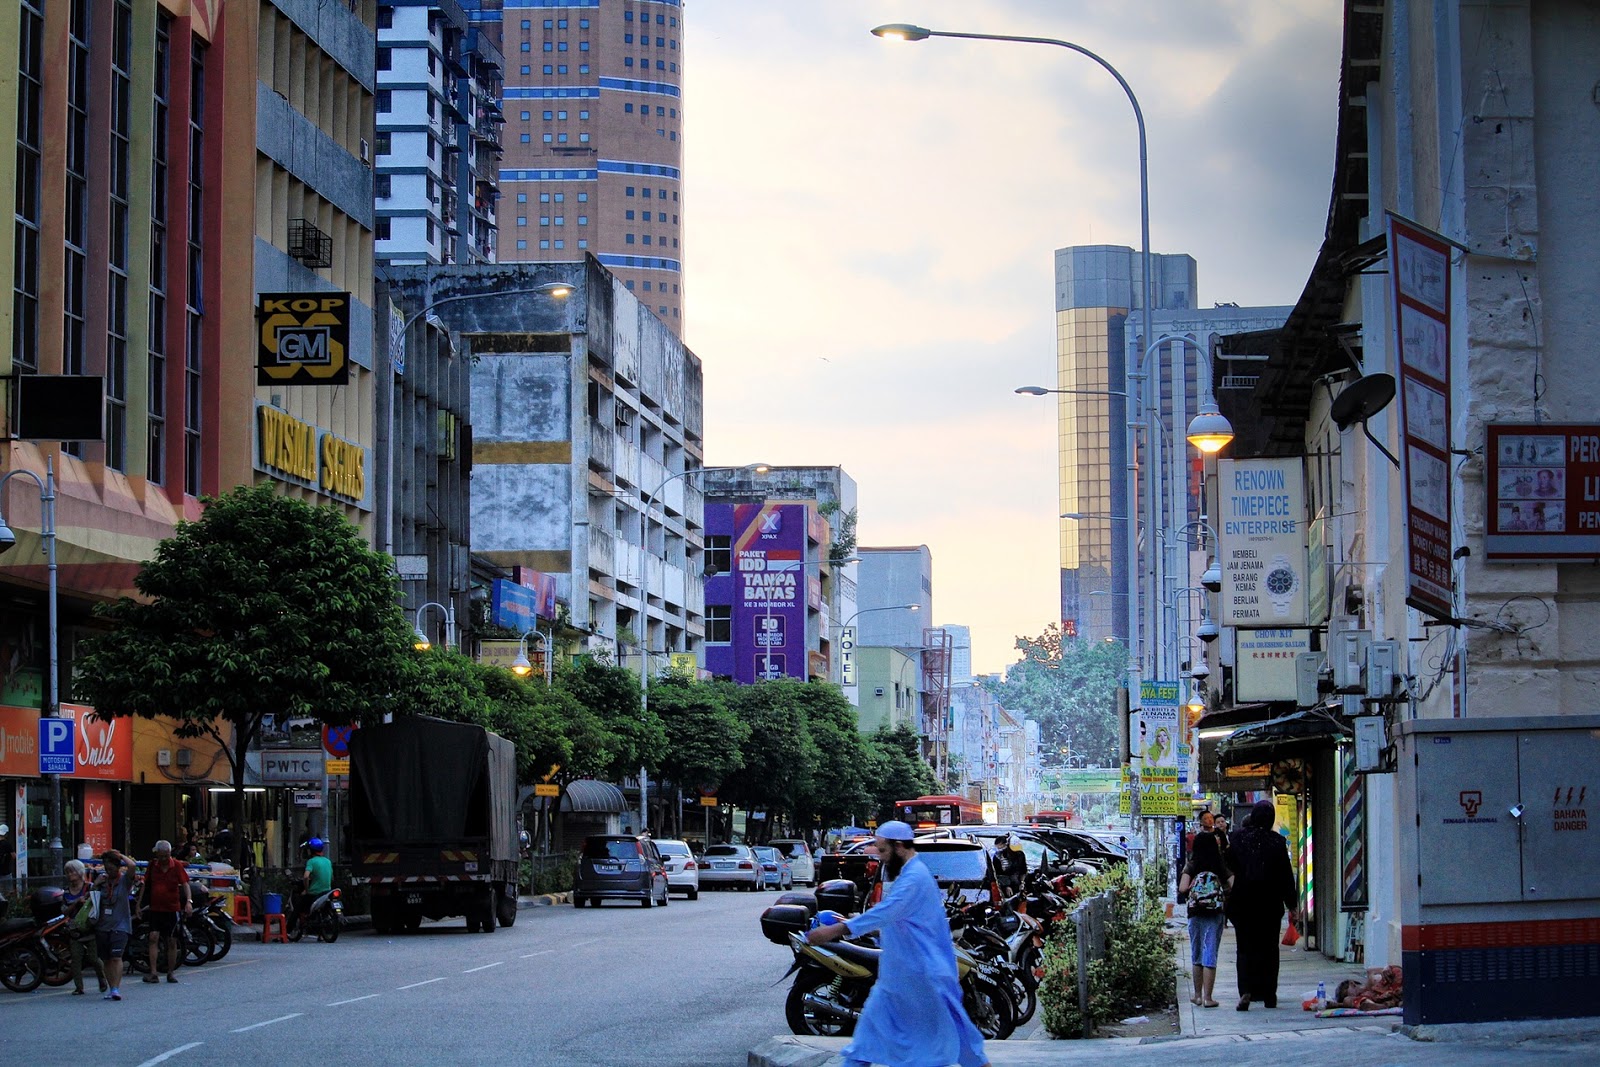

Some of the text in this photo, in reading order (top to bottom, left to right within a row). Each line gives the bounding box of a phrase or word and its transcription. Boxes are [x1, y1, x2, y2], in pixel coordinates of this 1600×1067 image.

[263, 298, 345, 313] KOP
[258, 405, 317, 482] WISMA
[1234, 469, 1285, 491] RENOWN
[1231, 495, 1290, 517] TIMEPIECE
[1225, 520, 1296, 535] ENTERPRISE
[738, 550, 766, 558] PAKET
[1232, 550, 1258, 559] MEMBELI
[738, 558, 766, 571] IDD
[1227, 560, 1264, 571] JAM JENAMA
[742, 573, 797, 586] TANPA
[1232, 573, 1258, 582] BARANG
[743, 586, 796, 600] BATAS
[1235, 582, 1256, 592] KEMAS
[1233, 595, 1259, 605] BERLIAN
[1232, 608, 1260, 619] PERMATA
[1254, 629, 1293, 639] CHOW KIT
[842, 629, 853, 685] HOTEL
[1140, 687, 1178, 700] AYA FEST
[7, 730, 34, 754] mobile
[49, 721, 68, 753] P
[78, 711, 115, 768] Smile
[43, 757, 71, 765] MOTOSIKAL
[48, 763, 68, 771] SAHAJA
[266, 760, 311, 773] PWTC
[1443, 817, 1466, 825] TENAGA
[1554, 809, 1587, 820] BAHAYA
[1554, 820, 1588, 831] DANGER
